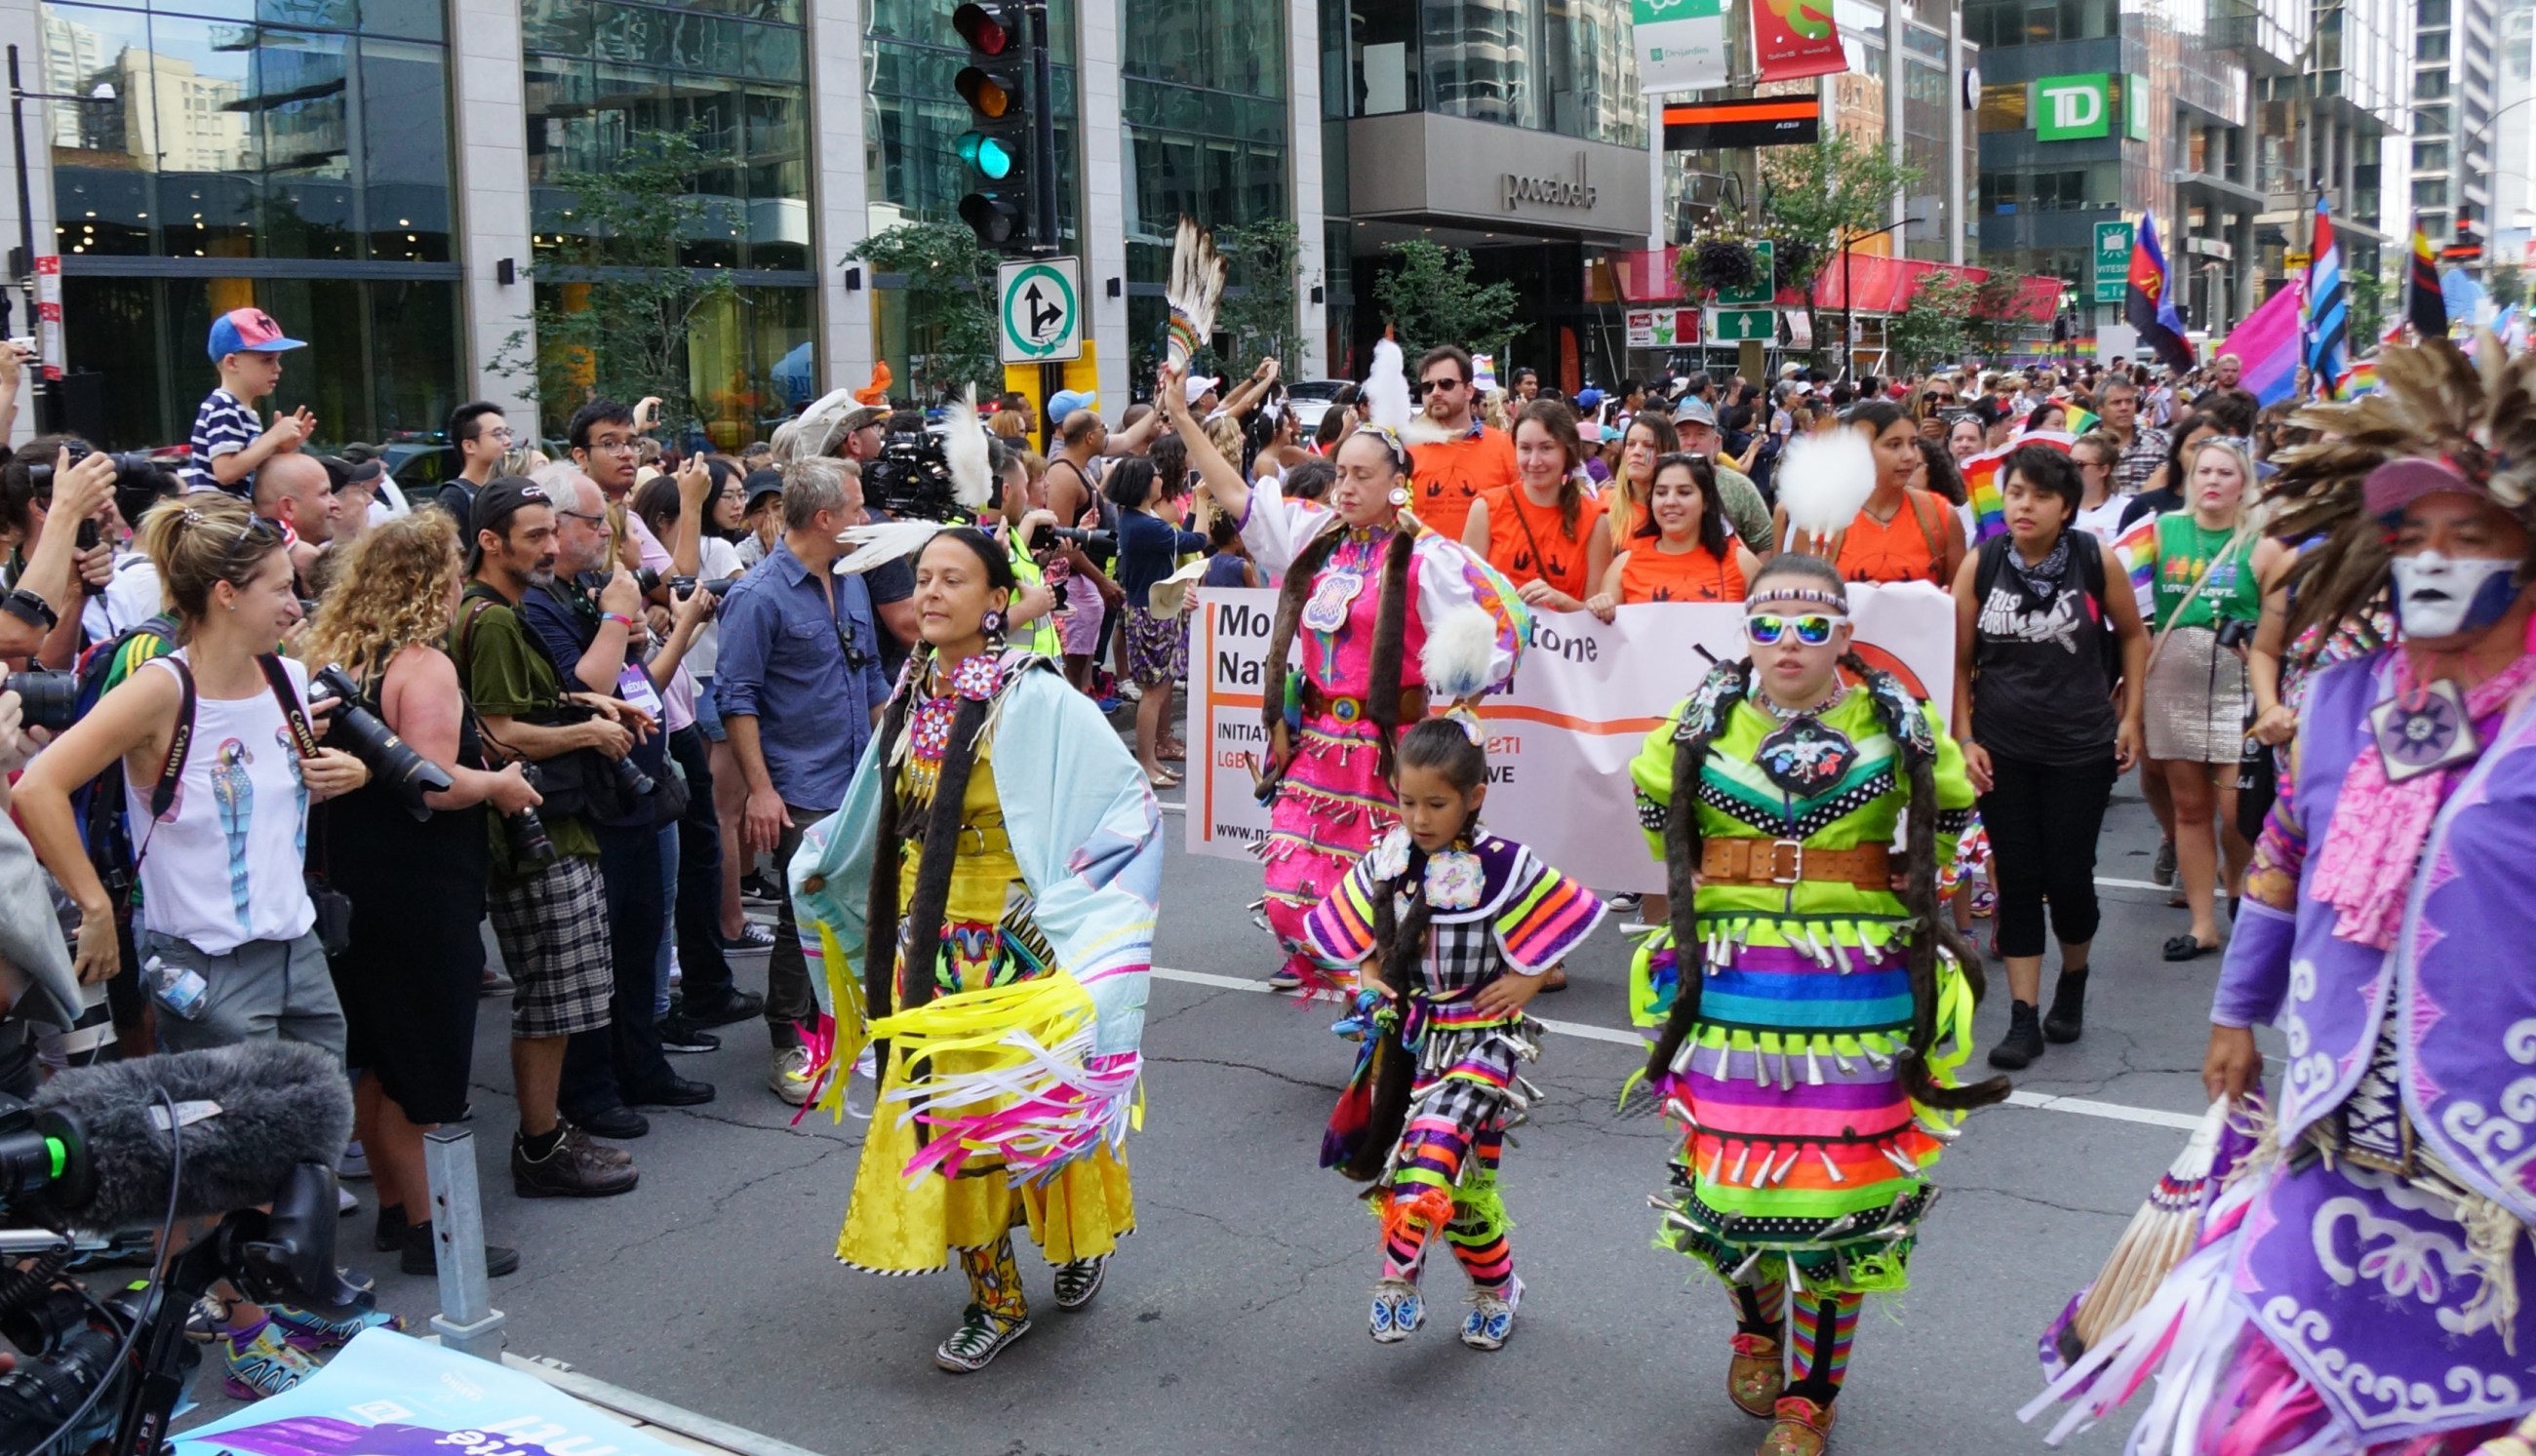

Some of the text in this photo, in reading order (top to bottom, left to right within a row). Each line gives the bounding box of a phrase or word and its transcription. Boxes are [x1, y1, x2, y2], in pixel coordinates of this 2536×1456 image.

[1665, 46, 1709, 59] Desjardins
[2041, 85, 2102, 129] TD
[2097, 264, 2130, 273] VITESS
[1218, 604, 1599, 663] Mo tone
[1218, 650, 1268, 686] Nat
[291, 710, 318, 758] Canon
[1217, 722, 1270, 743] INITIAT
[165, 724, 190, 778] Canon
[1216, 823, 1272, 842] www.na
